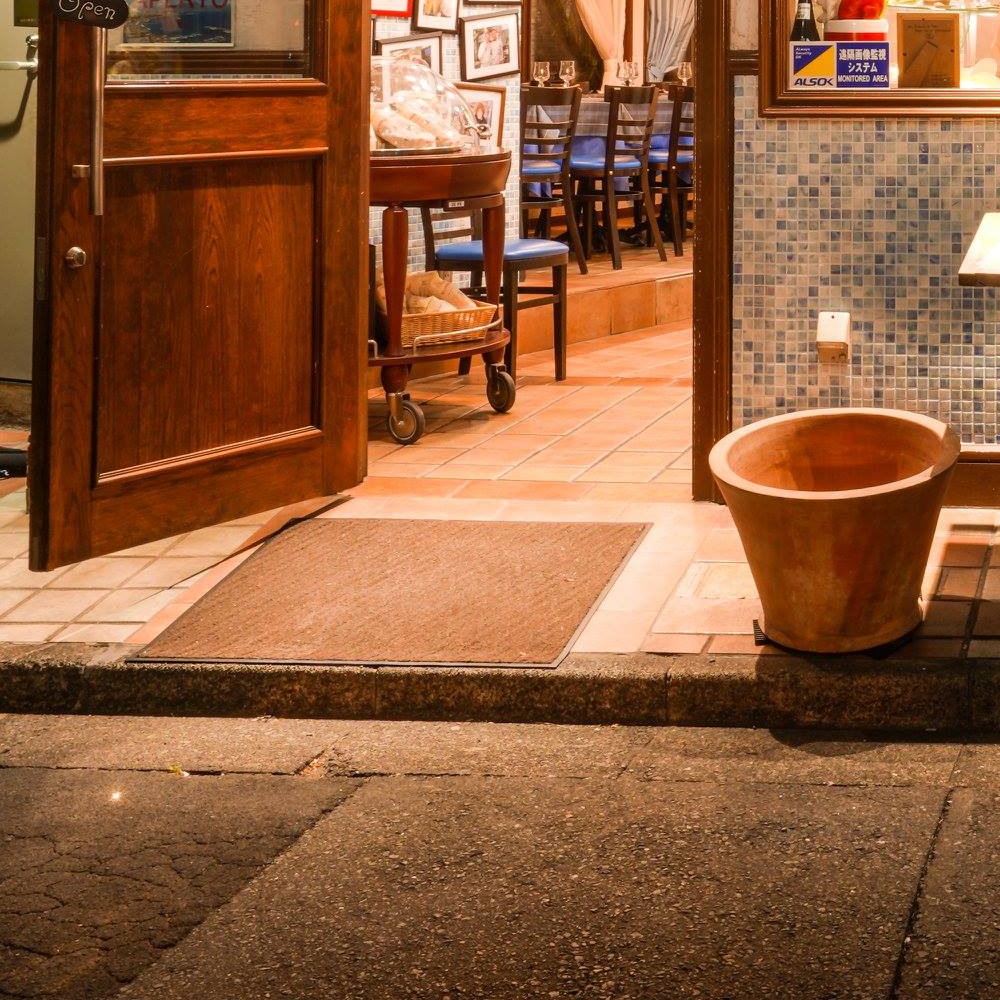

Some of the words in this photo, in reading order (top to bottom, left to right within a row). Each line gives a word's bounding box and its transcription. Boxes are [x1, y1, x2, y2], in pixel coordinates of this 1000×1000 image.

[847, 62, 878, 73] システム
[794, 77, 834, 87] ALSOK
[837, 75, 871, 83] MONITORED
[872, 75, 888, 83] AREA
